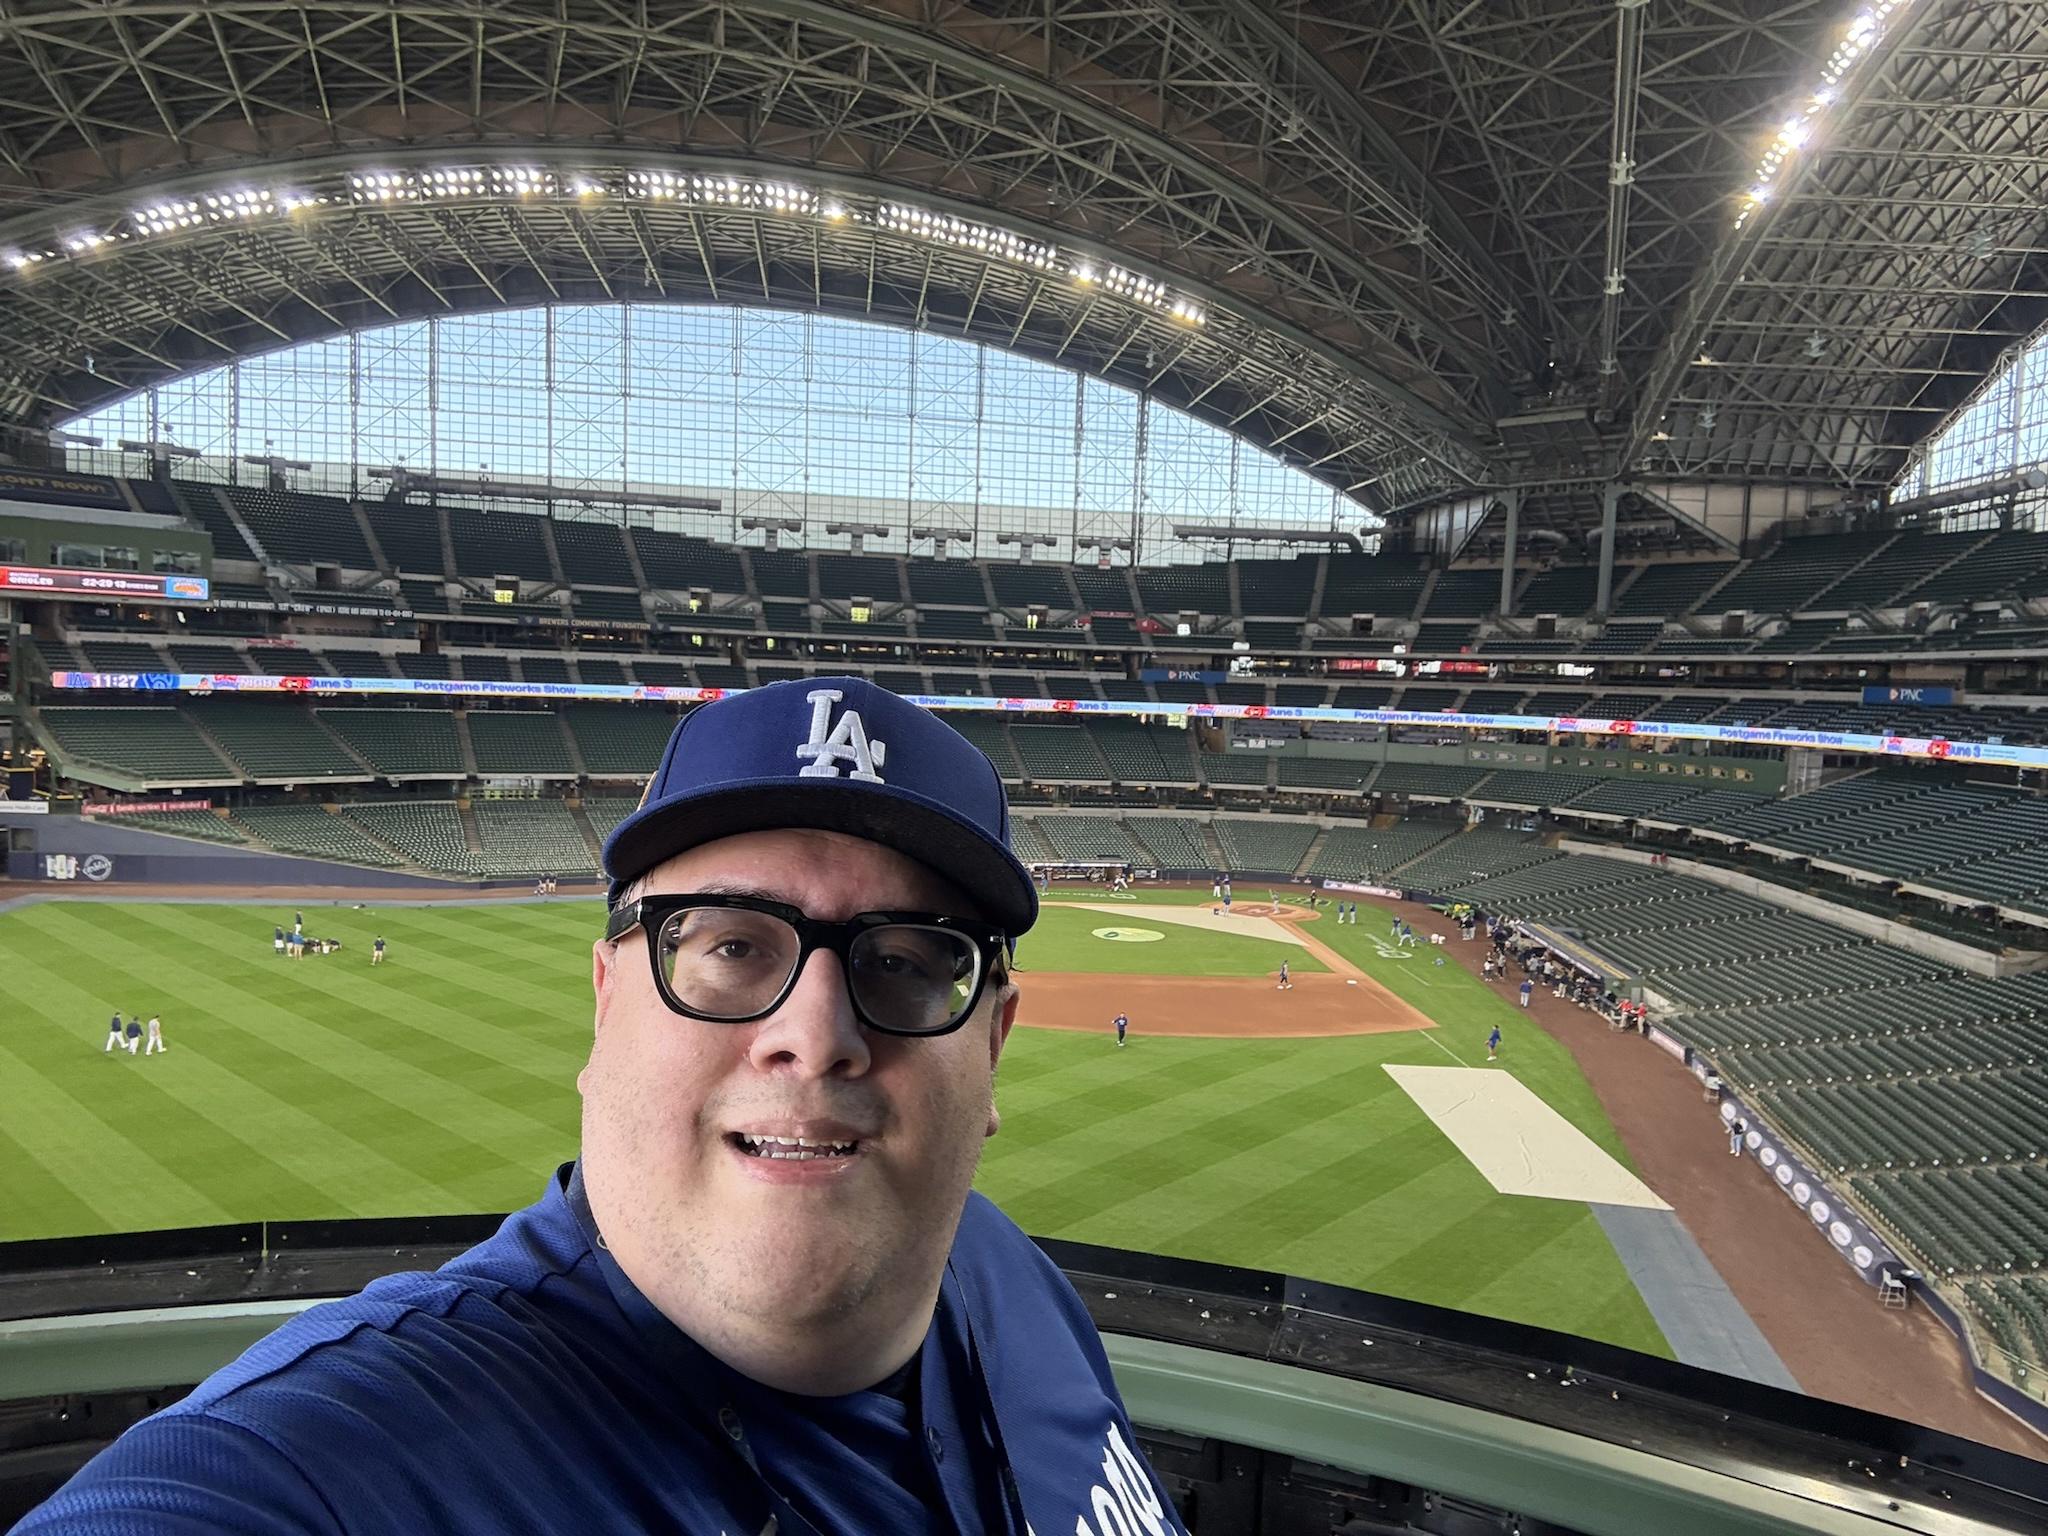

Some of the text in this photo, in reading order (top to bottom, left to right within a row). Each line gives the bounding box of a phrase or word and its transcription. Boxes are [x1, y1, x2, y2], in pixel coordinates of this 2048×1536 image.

[539, 617, 651, 630] BREWERS COMMUNITY FOUNDATION
[92, 674, 139, 688] 11:27
[1178, 670, 1201, 680] PNC
[312, 680, 341, 689] June
[343, 680, 352, 689] 3
[414, 681, 480, 693] Postgame
[482, 683, 541, 693] Fireworks
[543, 684, 577, 694] Show
[919, 696, 947, 705] Show
[1900, 688, 1923, 701] PNC
[1267, 708, 1293, 716] June
[1354, 710, 1409, 722] Postgame
[1411, 711, 1463, 723] Fireworks
[1465, 715, 1494, 724] Show
[1635, 724, 1659, 733] June
[1660, 725, 1668, 733] 3
[796, 689, 886, 785] LA
[1719, 728, 1772, 740] Postgame
[1773, 730, 1816, 743] Fireworks
[1818, 733, 1843, 745] Show
[1950, 745, 1972, 757] June
[1973, 745, 1982, 758] 3
